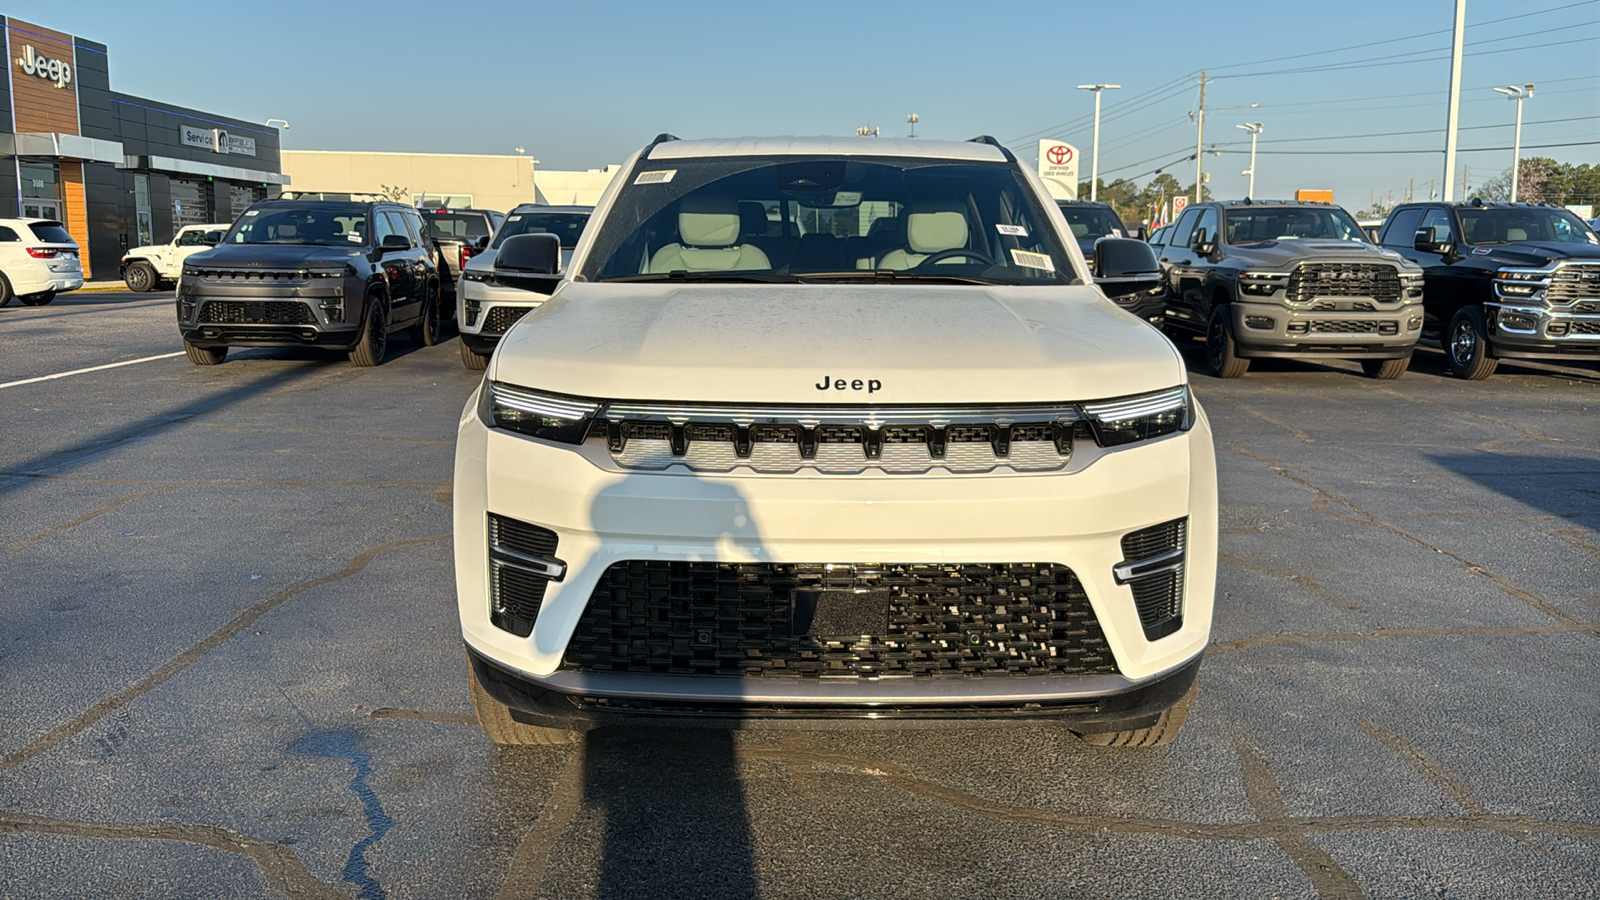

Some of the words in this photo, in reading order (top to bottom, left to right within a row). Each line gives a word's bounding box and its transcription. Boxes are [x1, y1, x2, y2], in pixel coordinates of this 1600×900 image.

[18, 44, 71, 89] Jeep
[186, 130, 214, 146] Service
[1320, 271, 1376, 280] RAM
[815, 375, 882, 394] Jeep
